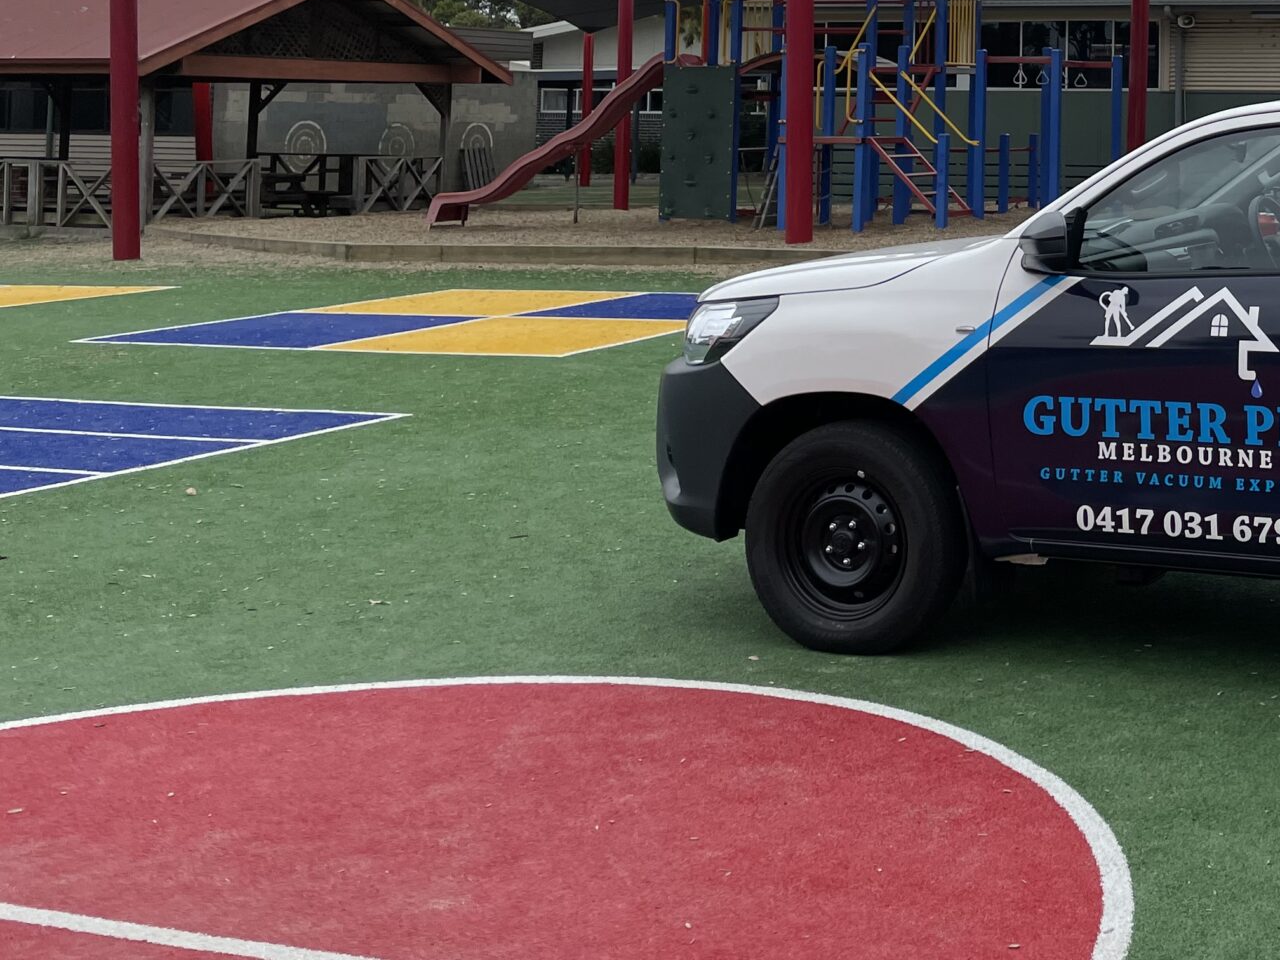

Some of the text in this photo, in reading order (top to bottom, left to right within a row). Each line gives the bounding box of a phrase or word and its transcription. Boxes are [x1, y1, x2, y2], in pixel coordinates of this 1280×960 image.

[1023, 395, 1230, 443] GUTTER
[1097, 440, 1274, 470] MELBOURNE
[1040, 466, 1124, 484] GUTTER
[1135, 471, 1224, 490] VACUUM
[1076, 504, 1155, 537] 0417
[1163, 509, 1225, 541] 031
